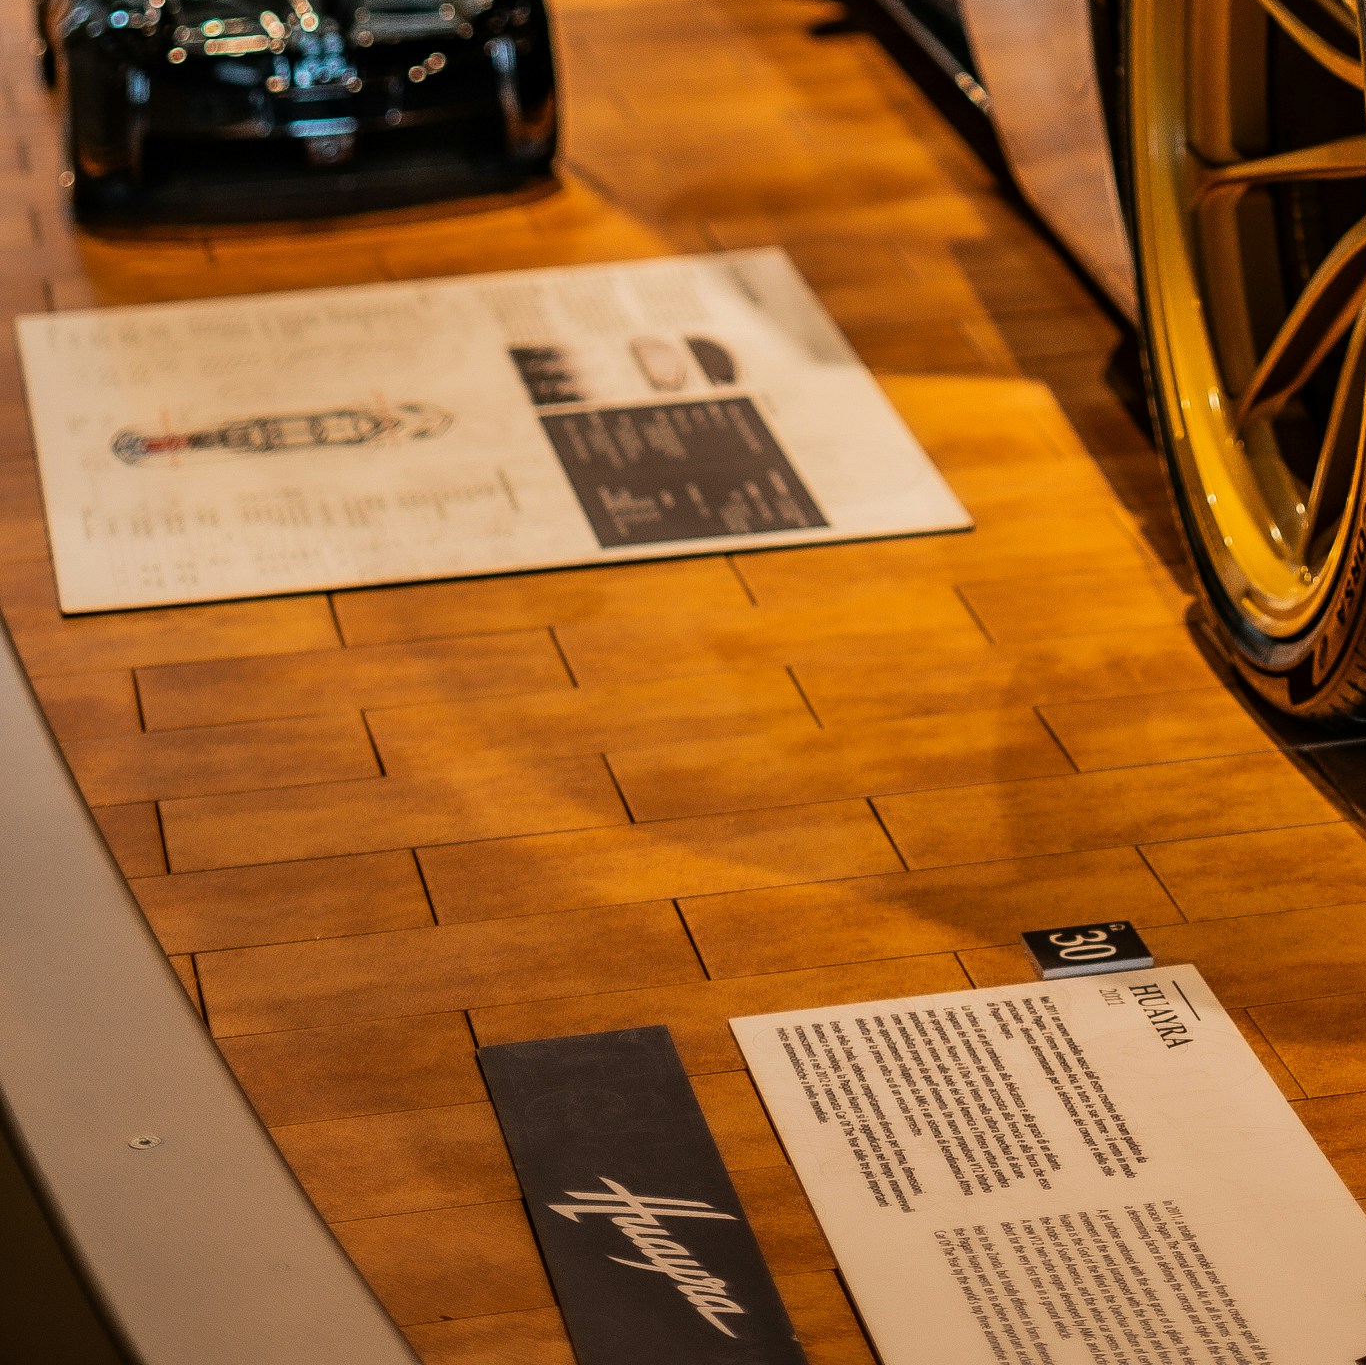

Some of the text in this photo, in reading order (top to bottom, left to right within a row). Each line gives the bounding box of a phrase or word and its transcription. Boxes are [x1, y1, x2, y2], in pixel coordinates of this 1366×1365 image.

[1049, 930, 1117, 961] 30
[1099, 988, 1126, 1007] 2011
[1129, 983, 1194, 1049] HUAYRA
[547, 1175, 746, 1339] Huayra
